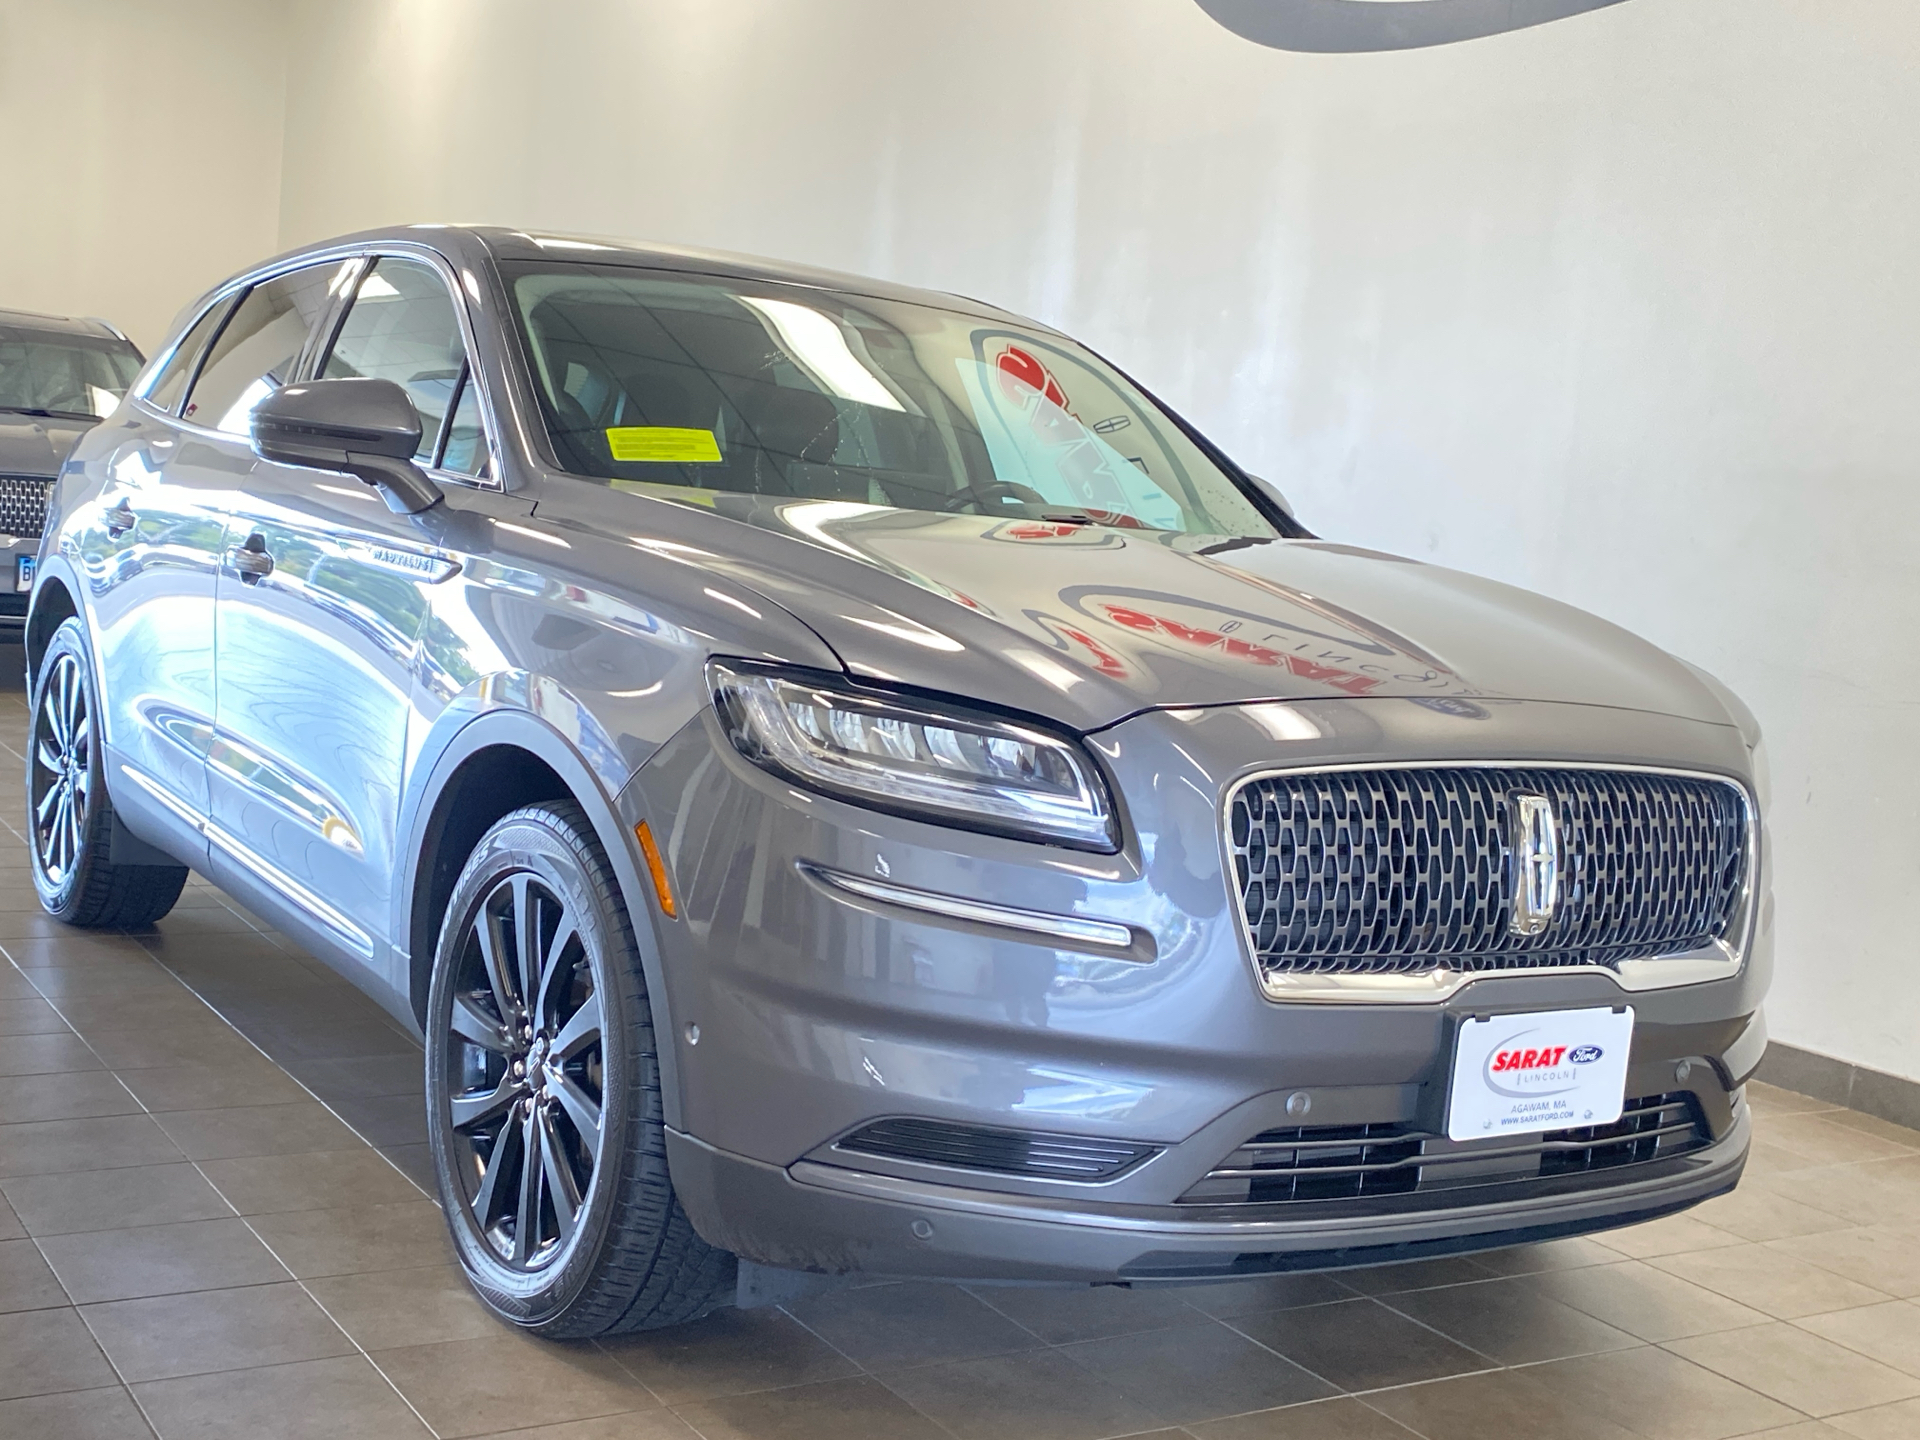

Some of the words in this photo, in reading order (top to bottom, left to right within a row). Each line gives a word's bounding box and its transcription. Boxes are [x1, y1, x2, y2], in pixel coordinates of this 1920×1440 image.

[452, 841, 491, 905] TIRES
[1491, 1045, 1568, 1072] SARAT
[1571, 1046, 1600, 1063] Ford
[1524, 1071, 1569, 1083] LINCOLN
[1511, 1102, 1551, 1114] AGAWAM,
[1553, 1100, 1567, 1109] MA
[1501, 1110, 1574, 1125] WWW.SARATFORD.COM
